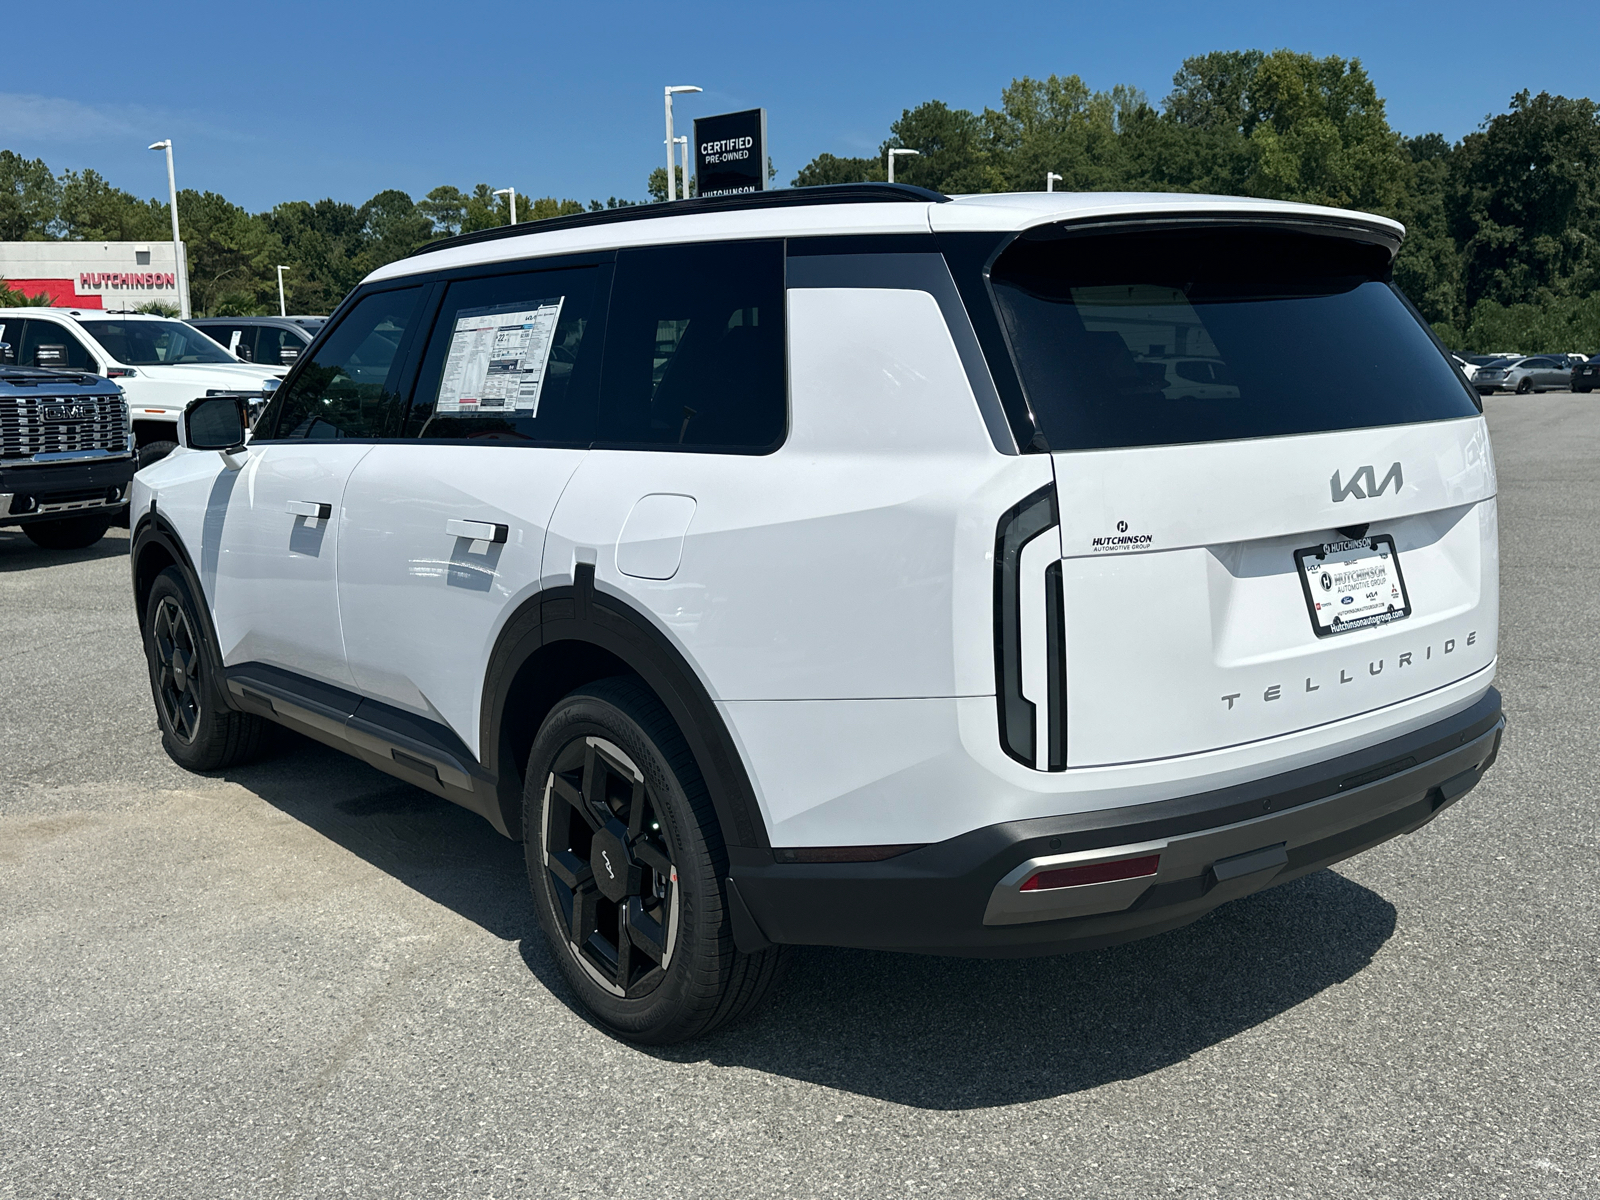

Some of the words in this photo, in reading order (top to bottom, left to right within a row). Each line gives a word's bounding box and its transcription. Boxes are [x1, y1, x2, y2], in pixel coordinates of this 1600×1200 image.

[701, 136, 753, 155] CERTIFIED
[705, 150, 749, 165] PRE-OWNED
[80, 272, 175, 286] HUTCHINSON
[45, 404, 97, 420] GMC
[1329, 461, 1404, 503] KIA
[1092, 534, 1153, 546] HUTCHINSON
[1331, 538, 1372, 553] HUTCHINSON
[1334, 565, 1387, 586] HUTCHINSON
[1338, 580, 1370, 593] AUTOMOTIVE
[1370, 577, 1387, 587] GROUP
[1330, 609, 1404, 633] Hutchinsonautogroup.com
[1221, 631, 1477, 710] TELLURIDE
